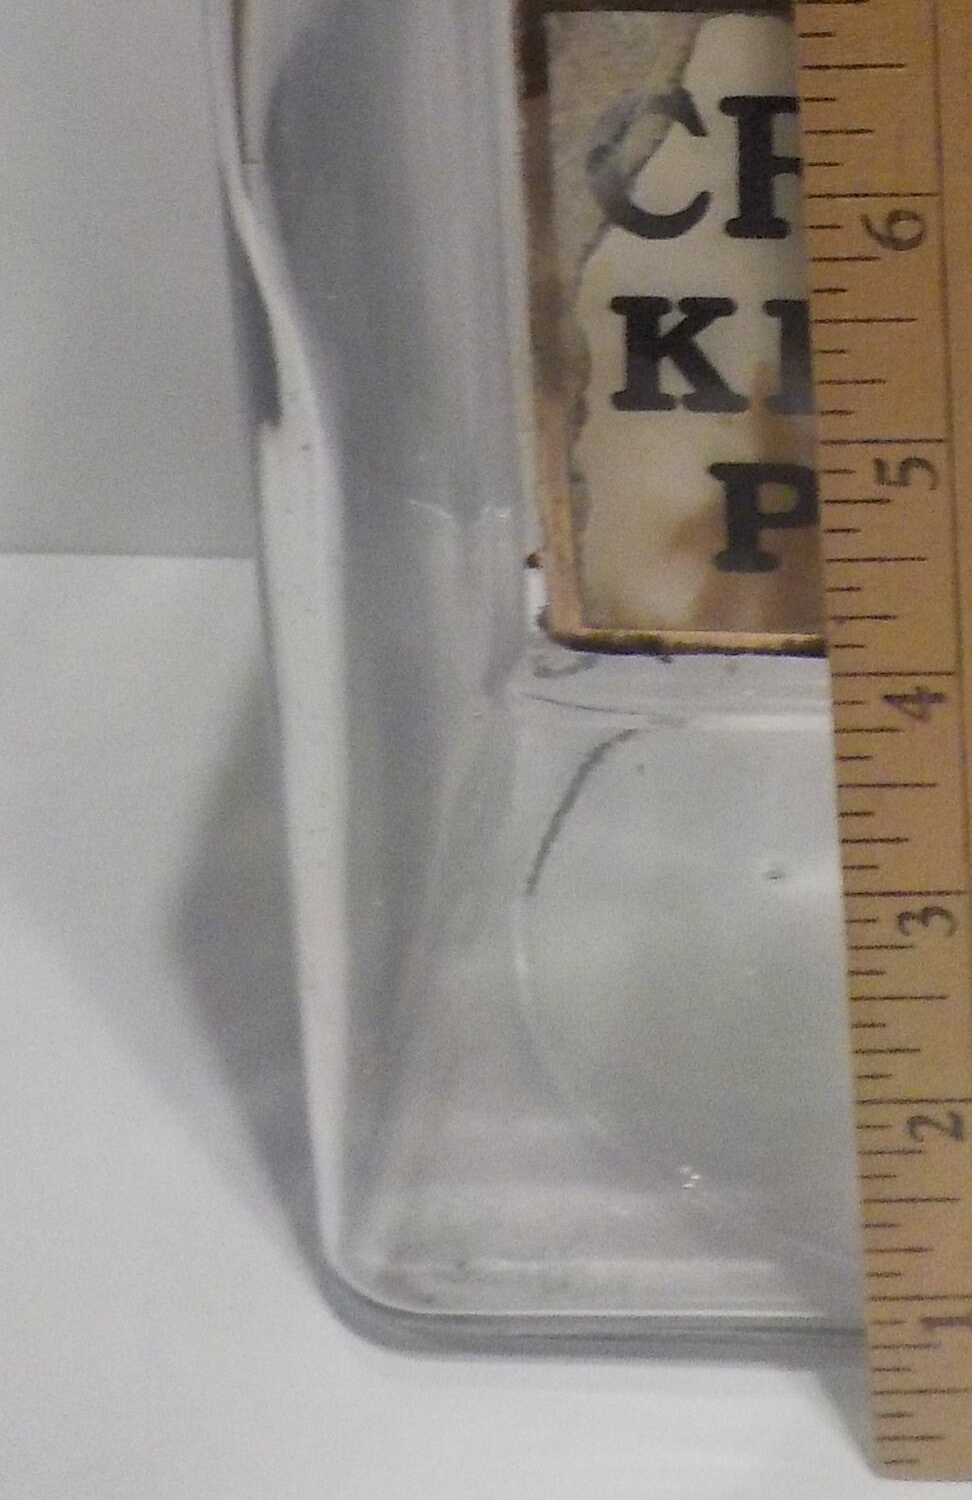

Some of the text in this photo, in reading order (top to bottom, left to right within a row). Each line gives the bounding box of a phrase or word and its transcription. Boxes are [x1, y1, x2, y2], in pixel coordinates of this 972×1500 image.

[859, 208, 929, 253] 6
[873, 455, 940, 491] 5
[881, 685, 946, 722] 4
[895, 905, 957, 939] 3
[907, 1110, 966, 1143] 2
